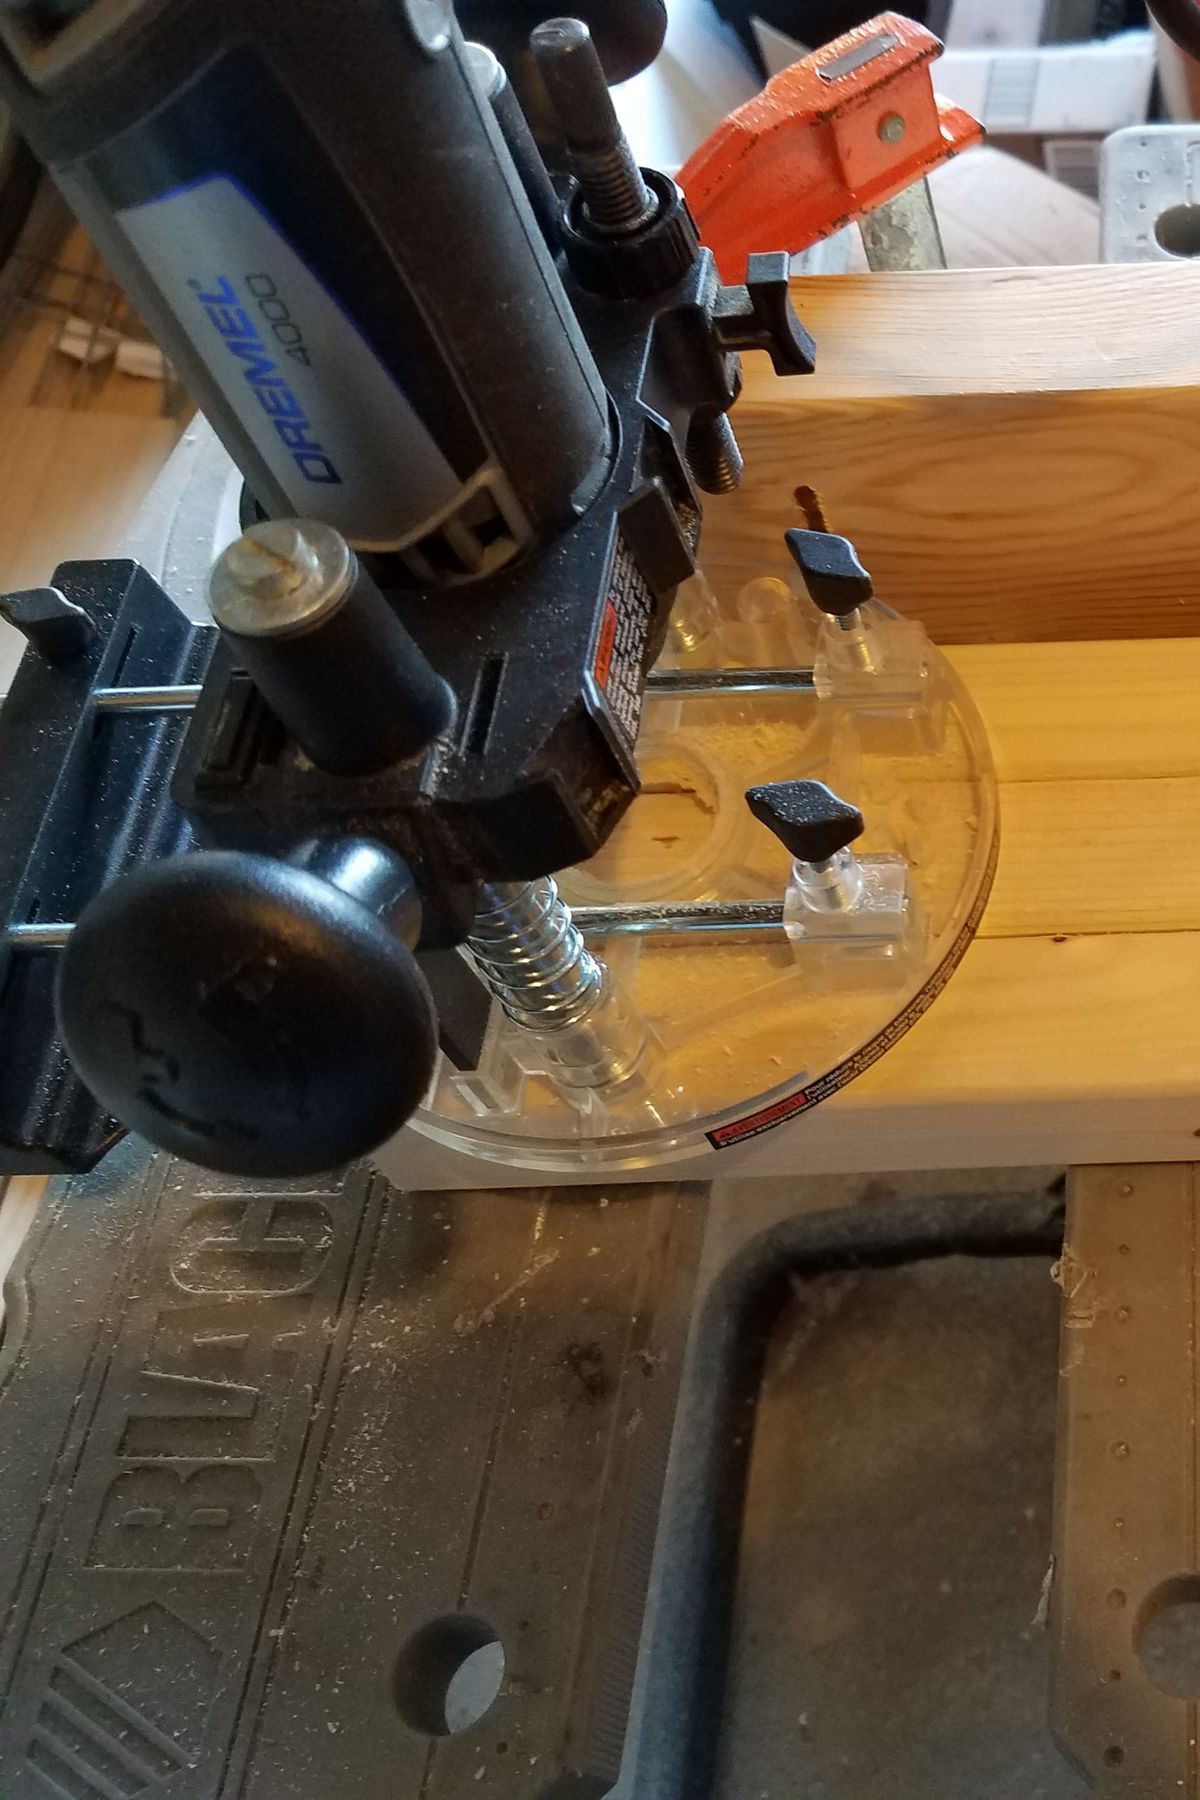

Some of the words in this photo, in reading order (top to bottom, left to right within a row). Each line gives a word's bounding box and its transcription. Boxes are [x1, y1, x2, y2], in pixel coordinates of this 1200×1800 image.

[199, 275, 342, 484] DREMEL
[246, 274, 312, 367] 4000
[79, 1168, 345, 1572] BLAC
